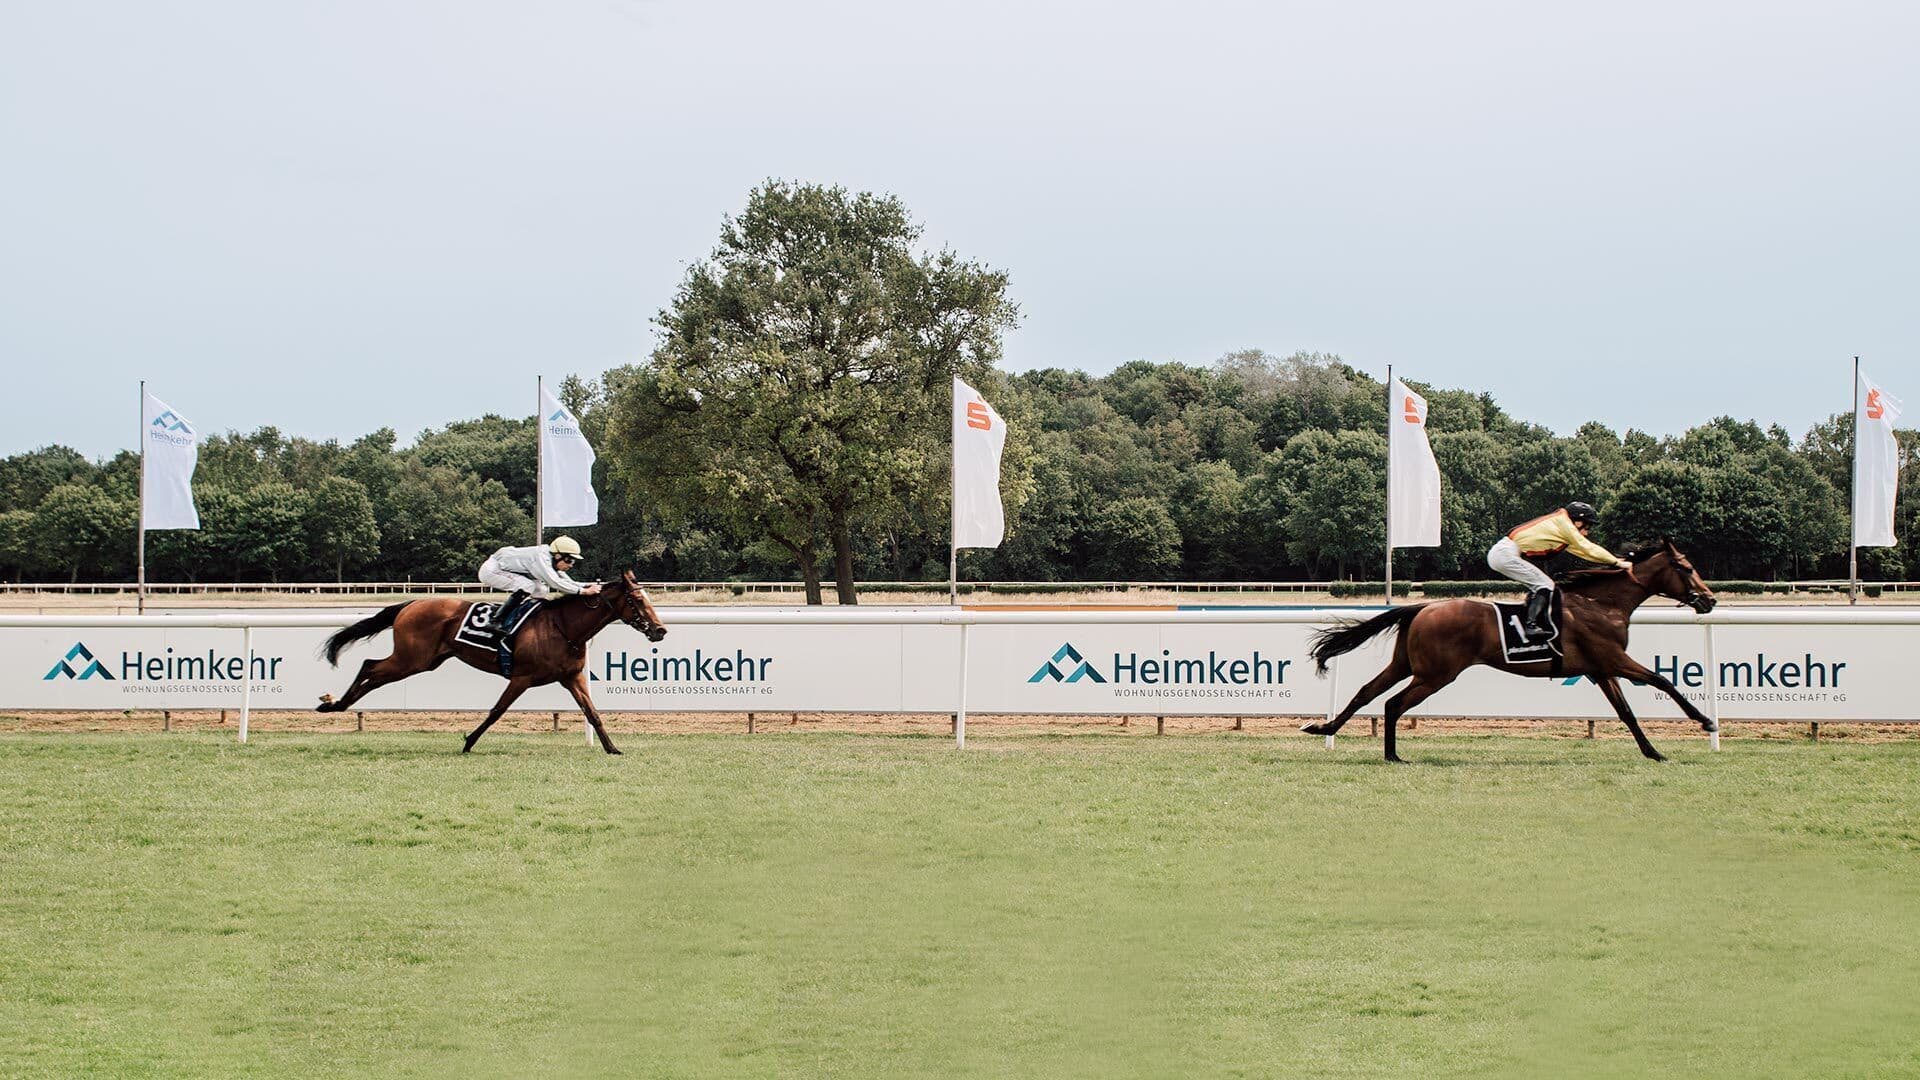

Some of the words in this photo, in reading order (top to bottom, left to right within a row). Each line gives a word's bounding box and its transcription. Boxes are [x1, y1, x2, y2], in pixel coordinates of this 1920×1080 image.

[471, 605, 493, 628] 3
[1508, 614, 1530, 644] 1
[122, 647, 283, 681] Heimkehr
[605, 648, 773, 682] Heimkehr
[1113, 650, 1292, 685] Heimkehr
[1653, 653, 1847, 688] Hemkehr
[122, 685, 267, 694] WOHNUNGSGENOSSENSCAFT
[271, 685, 283, 694] eG
[606, 686, 757, 695] WOHNUNGSGENOSSENSCHAFT
[760, 686, 773, 695] eG
[1114, 689, 1274, 698] WOHNUNGSGENOSSENSCHAFT
[1278, 689, 1292, 698] eG
[1654, 692, 1828, 702] WONUNSGENOSSENSCHAFT
[1832, 692, 1847, 702] eG
